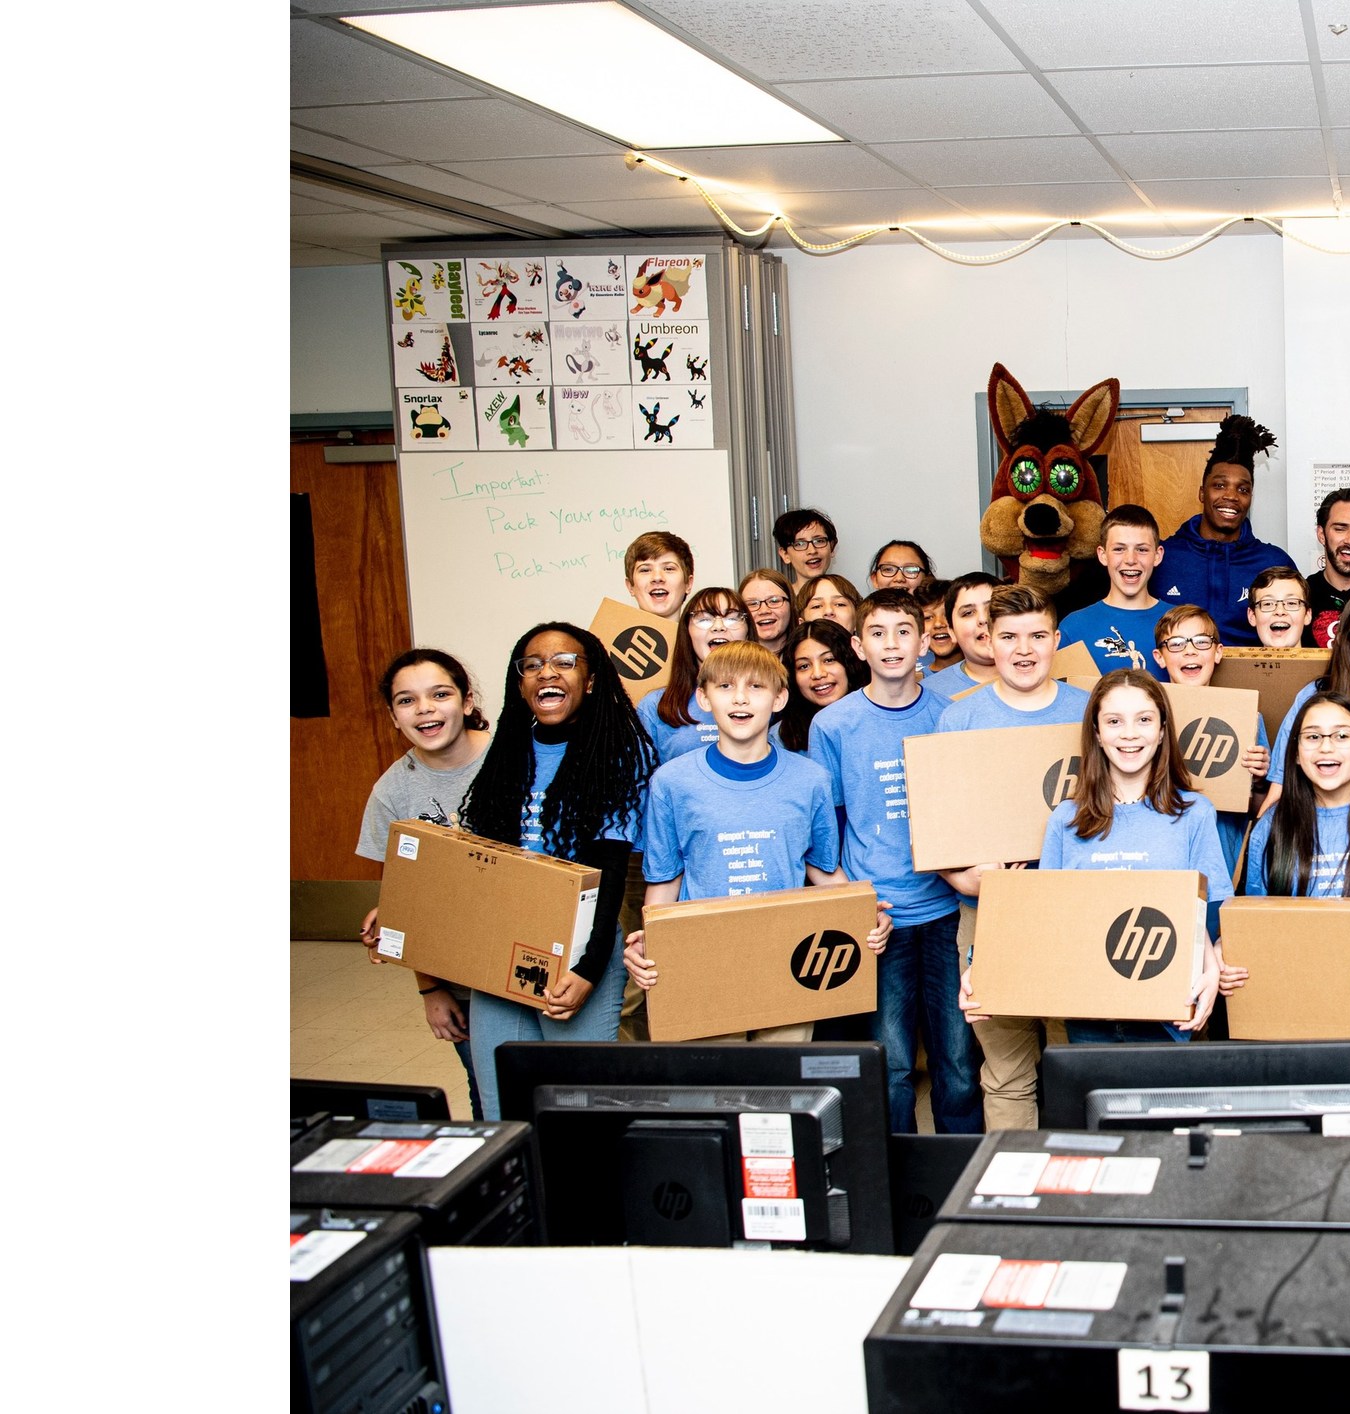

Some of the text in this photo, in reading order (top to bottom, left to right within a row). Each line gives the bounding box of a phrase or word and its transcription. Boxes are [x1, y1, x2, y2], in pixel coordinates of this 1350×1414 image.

[646, 257, 690, 267] Flareon
[447, 261, 465, 320] Bayleef
[553, 324, 604, 339] Mewtwo
[640, 323, 698, 335] Umbreon
[403, 394, 443, 403] Snorlax
[561, 387, 590, 399] Mew
[484, 390, 506, 421] AXEW
[433, 462, 550, 500] Important:
[486, 506, 538, 534] Pack
[599, 500, 669, 532] agendas
[494, 552, 546, 580] Pack
[610, 627, 668, 678] hp
[1183, 717, 1236, 778] hp
[874, 759, 899, 770] @import
[884, 785, 901, 794] color:
[886, 811, 901, 820] fear:
[717, 831, 745, 843] @import
[722, 844, 755, 857] coderpals
[728, 858, 764, 870] color: blue;
[728, 873, 761, 883] awesome:
[1111, 907, 1172, 980] hp
[522, 954, 538, 964] 3481
[538, 958, 549, 968] UN
[798, 930, 856, 990] hp
[1137, 1364, 1193, 1402] 13
